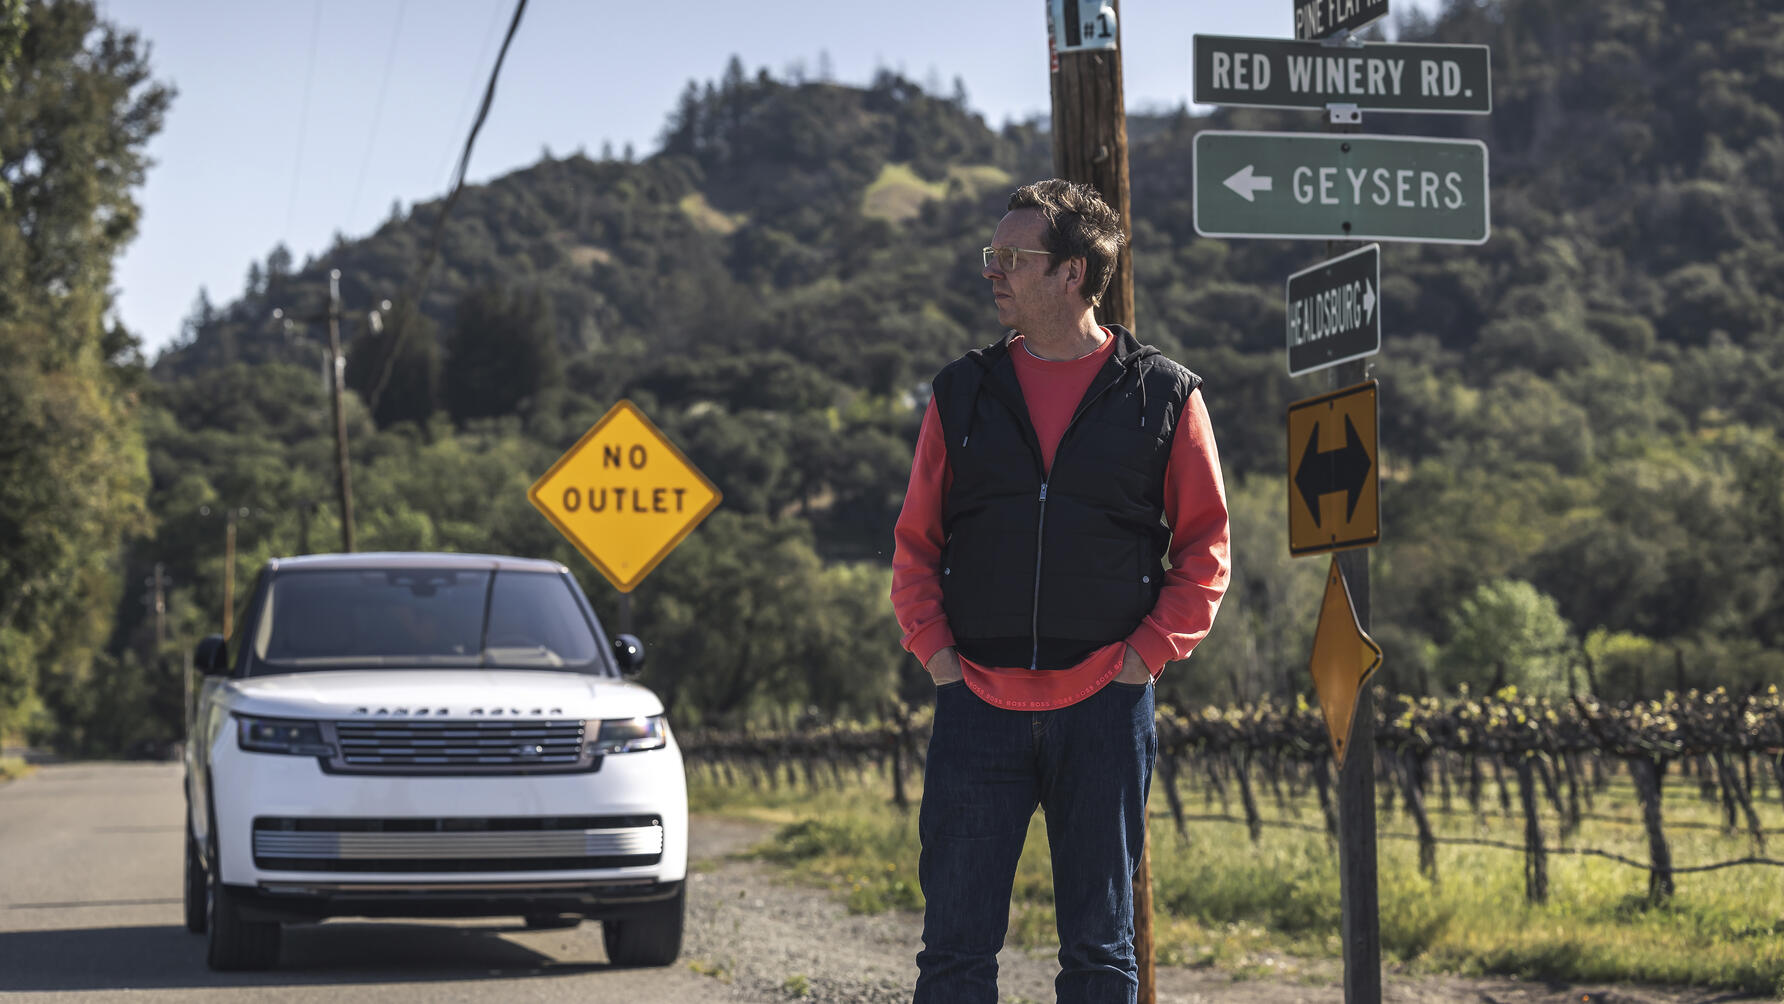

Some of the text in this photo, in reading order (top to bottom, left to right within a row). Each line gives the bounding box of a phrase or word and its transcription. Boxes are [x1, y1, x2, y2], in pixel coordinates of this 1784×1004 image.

[1083, 13, 1112, 39] #1
[1296, 0, 1324, 40] PINE
[1212, 51, 1473, 98] RED WINERY RD.
[1293, 166, 1464, 209] GEYSERS
[1288, 280, 1361, 347] HEALDSBURG
[603, 444, 647, 470] NO
[562, 486, 687, 513] OUTLET
